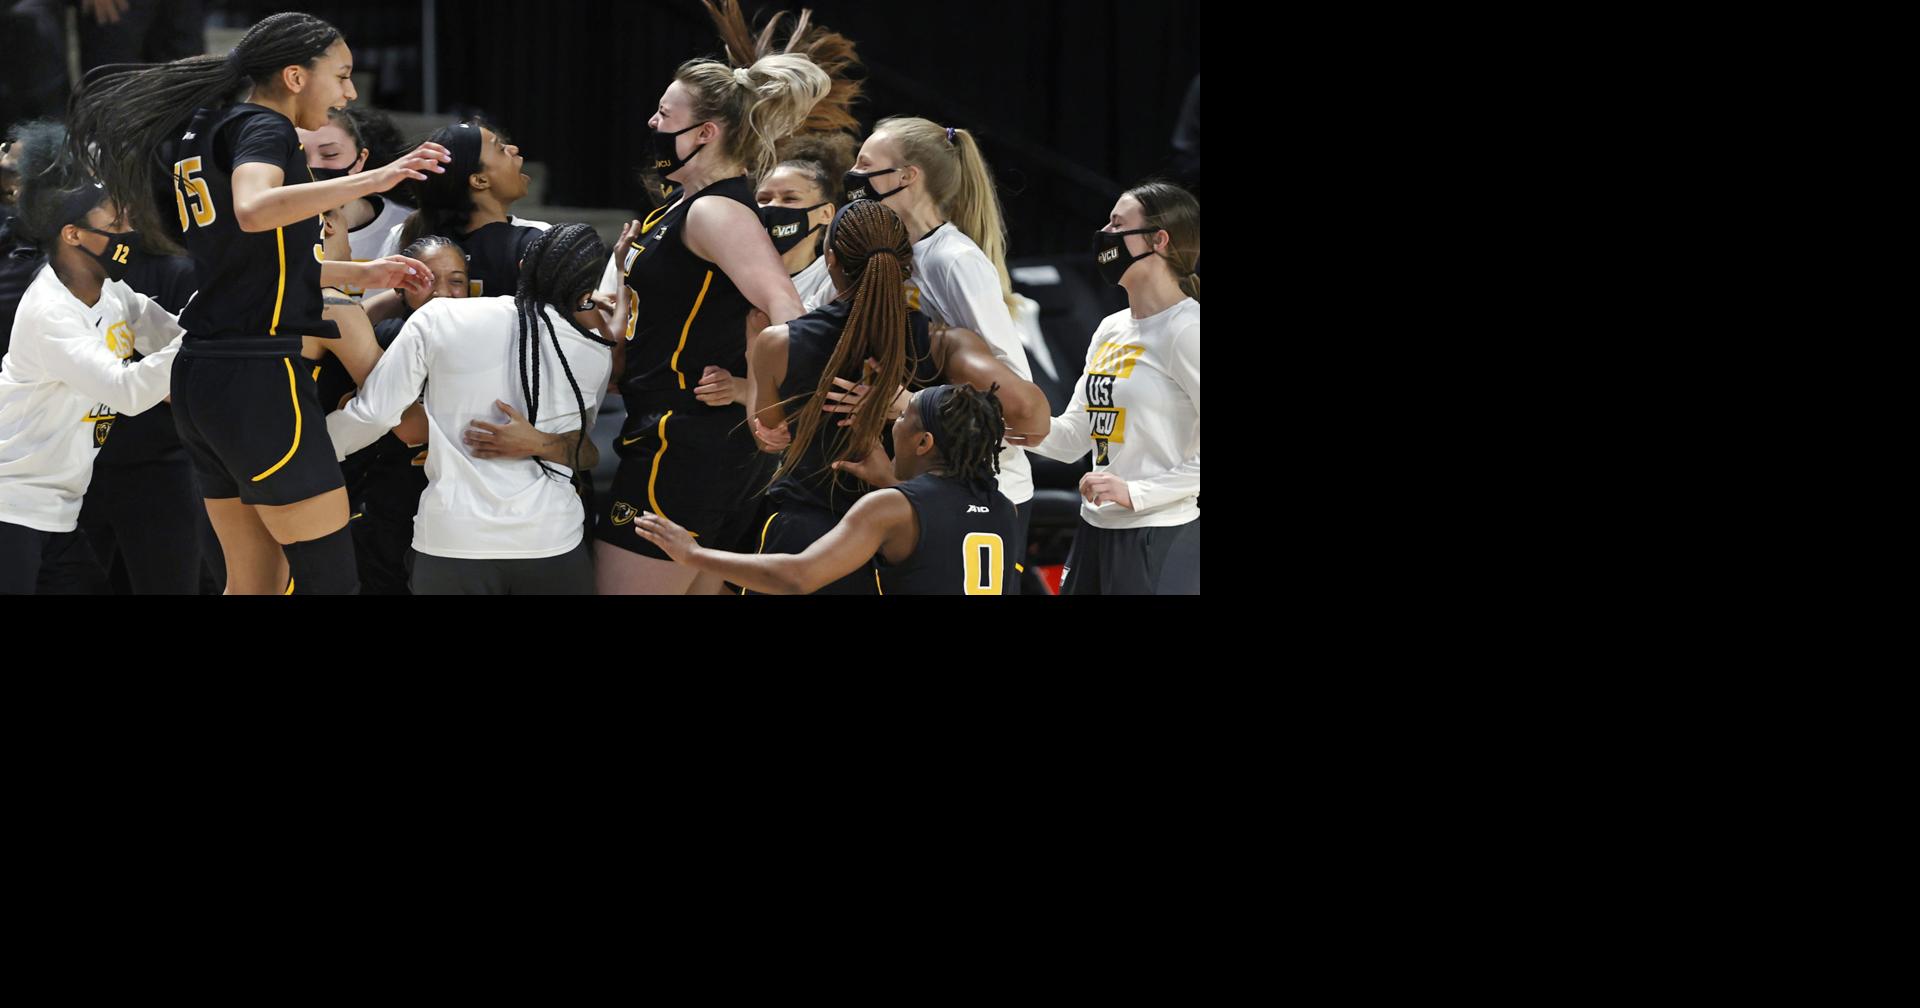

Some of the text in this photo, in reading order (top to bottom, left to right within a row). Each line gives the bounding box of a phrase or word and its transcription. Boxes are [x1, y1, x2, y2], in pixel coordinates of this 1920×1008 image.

[778, 222, 799, 237] VCU
[112, 243, 130, 265] 12
[1101, 247, 1118, 263] VCU
[1089, 375, 1111, 406] US
[962, 532, 1004, 595] 0
